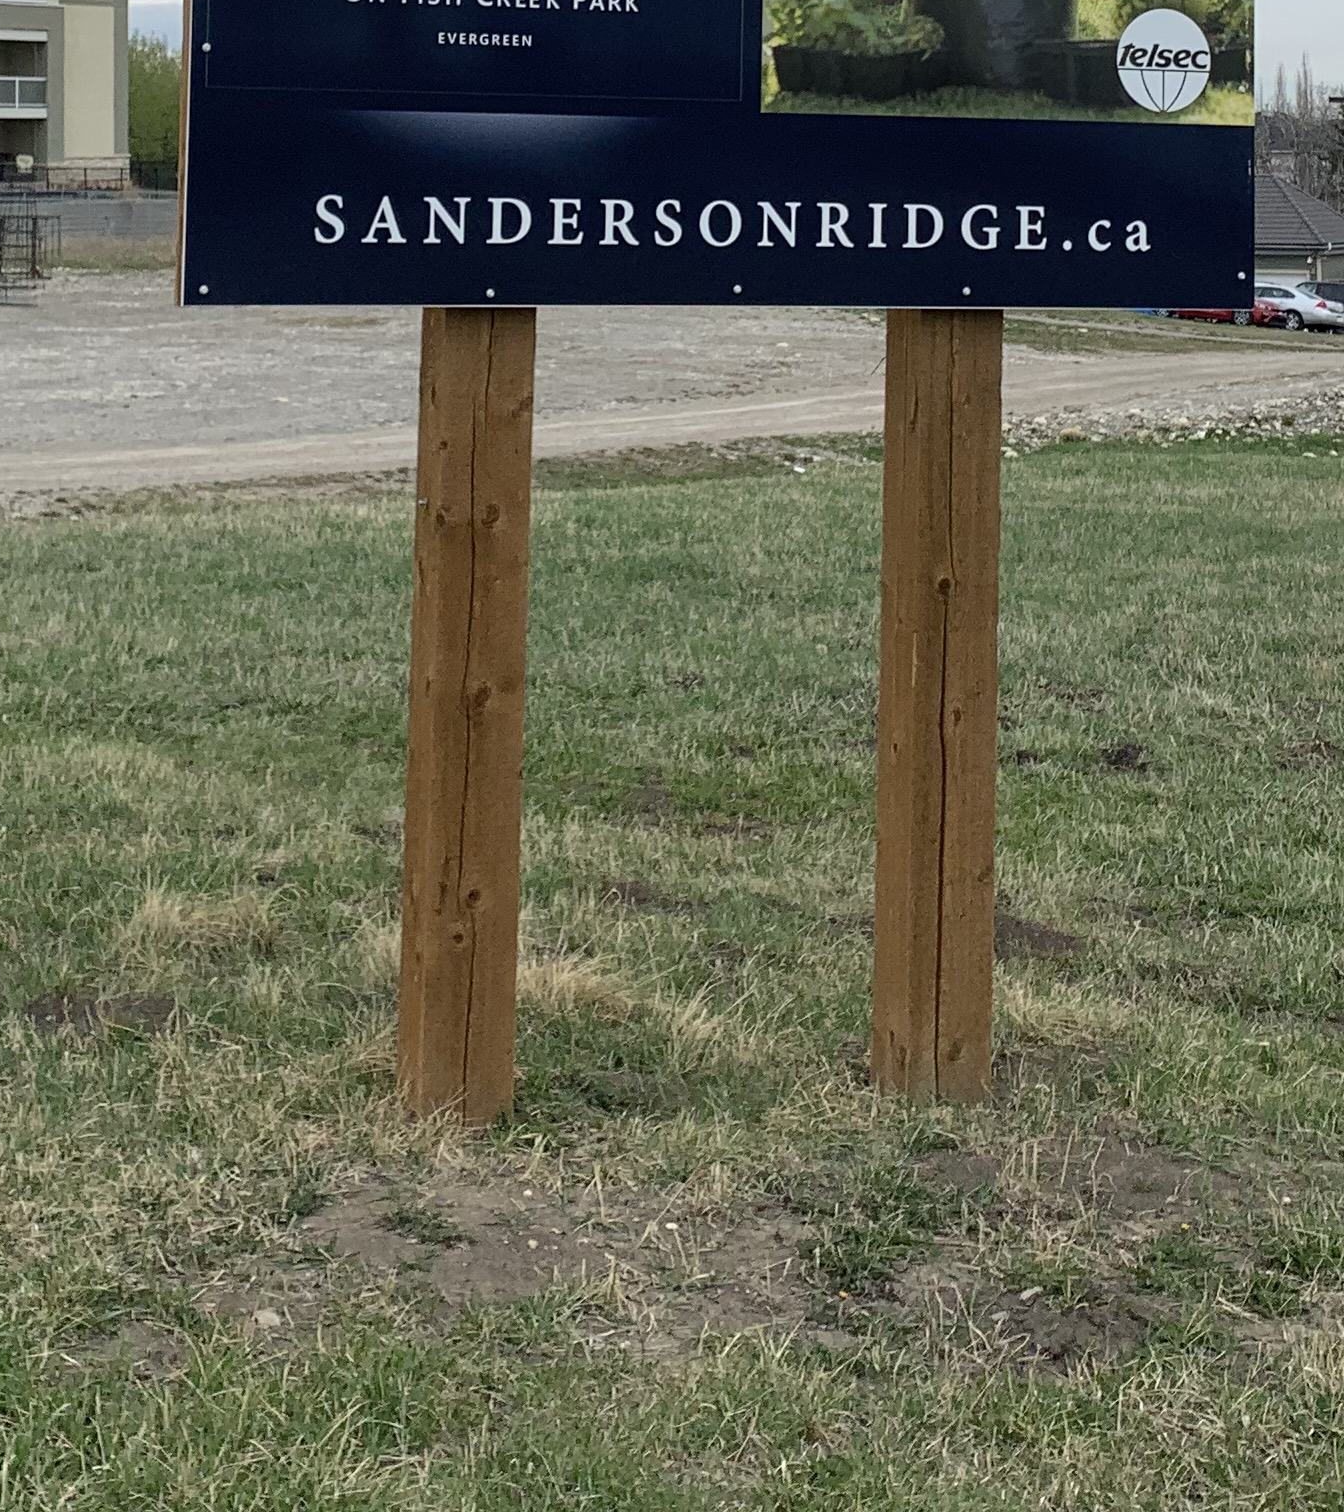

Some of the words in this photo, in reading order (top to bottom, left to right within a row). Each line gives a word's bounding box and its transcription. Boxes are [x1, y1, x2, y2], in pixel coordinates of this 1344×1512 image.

[437, 32, 533, 47] EVERGREEN
[1118, 43, 1209, 69] telsec
[313, 194, 1151, 252] SANDERSONRIDGE.ca
